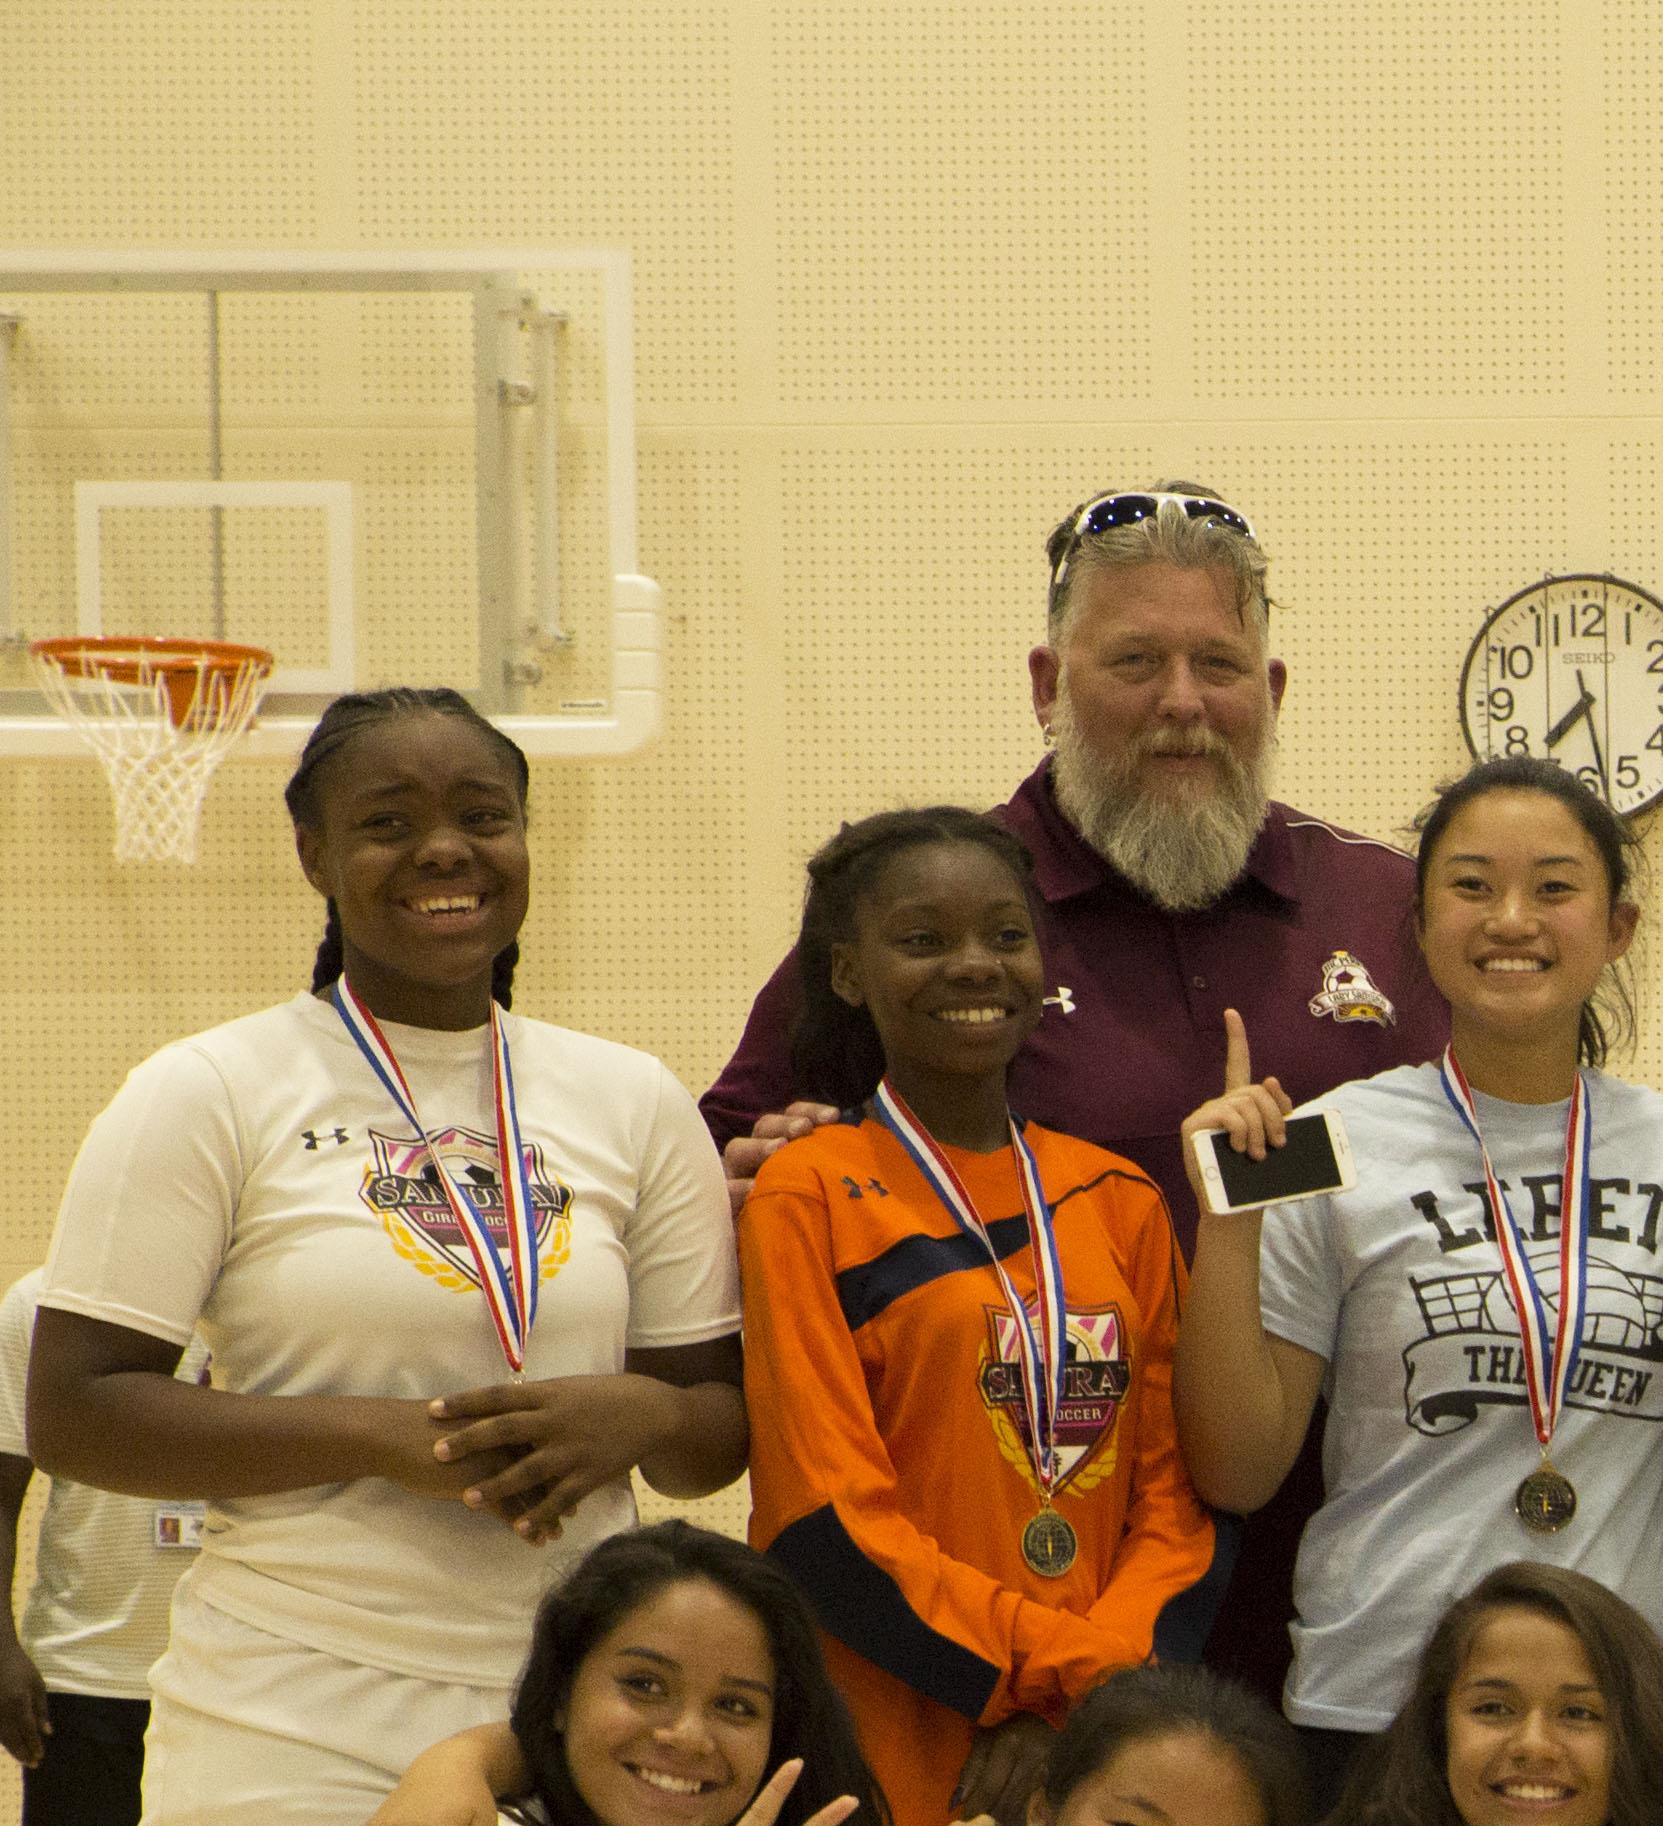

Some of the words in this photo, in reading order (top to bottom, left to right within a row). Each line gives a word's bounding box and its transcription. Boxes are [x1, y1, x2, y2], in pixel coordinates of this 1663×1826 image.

[1536, 613, 1559, 647] 11
[1571, 604, 1605, 638] 12
[1625, 612, 1631, 645] 1
[1500, 645, 1533, 680] 10
[1562, 652, 1615, 664] SEIKO
[1487, 687, 1514, 721] 9
[1505, 725, 1529, 757] 8
[1616, 755, 1640, 789] 5
[375, 1178, 562, 1208] SAUAI
[1571, 1359, 1654, 1407] UEEN
[1056, 1408, 1102, 1421] OCCER
